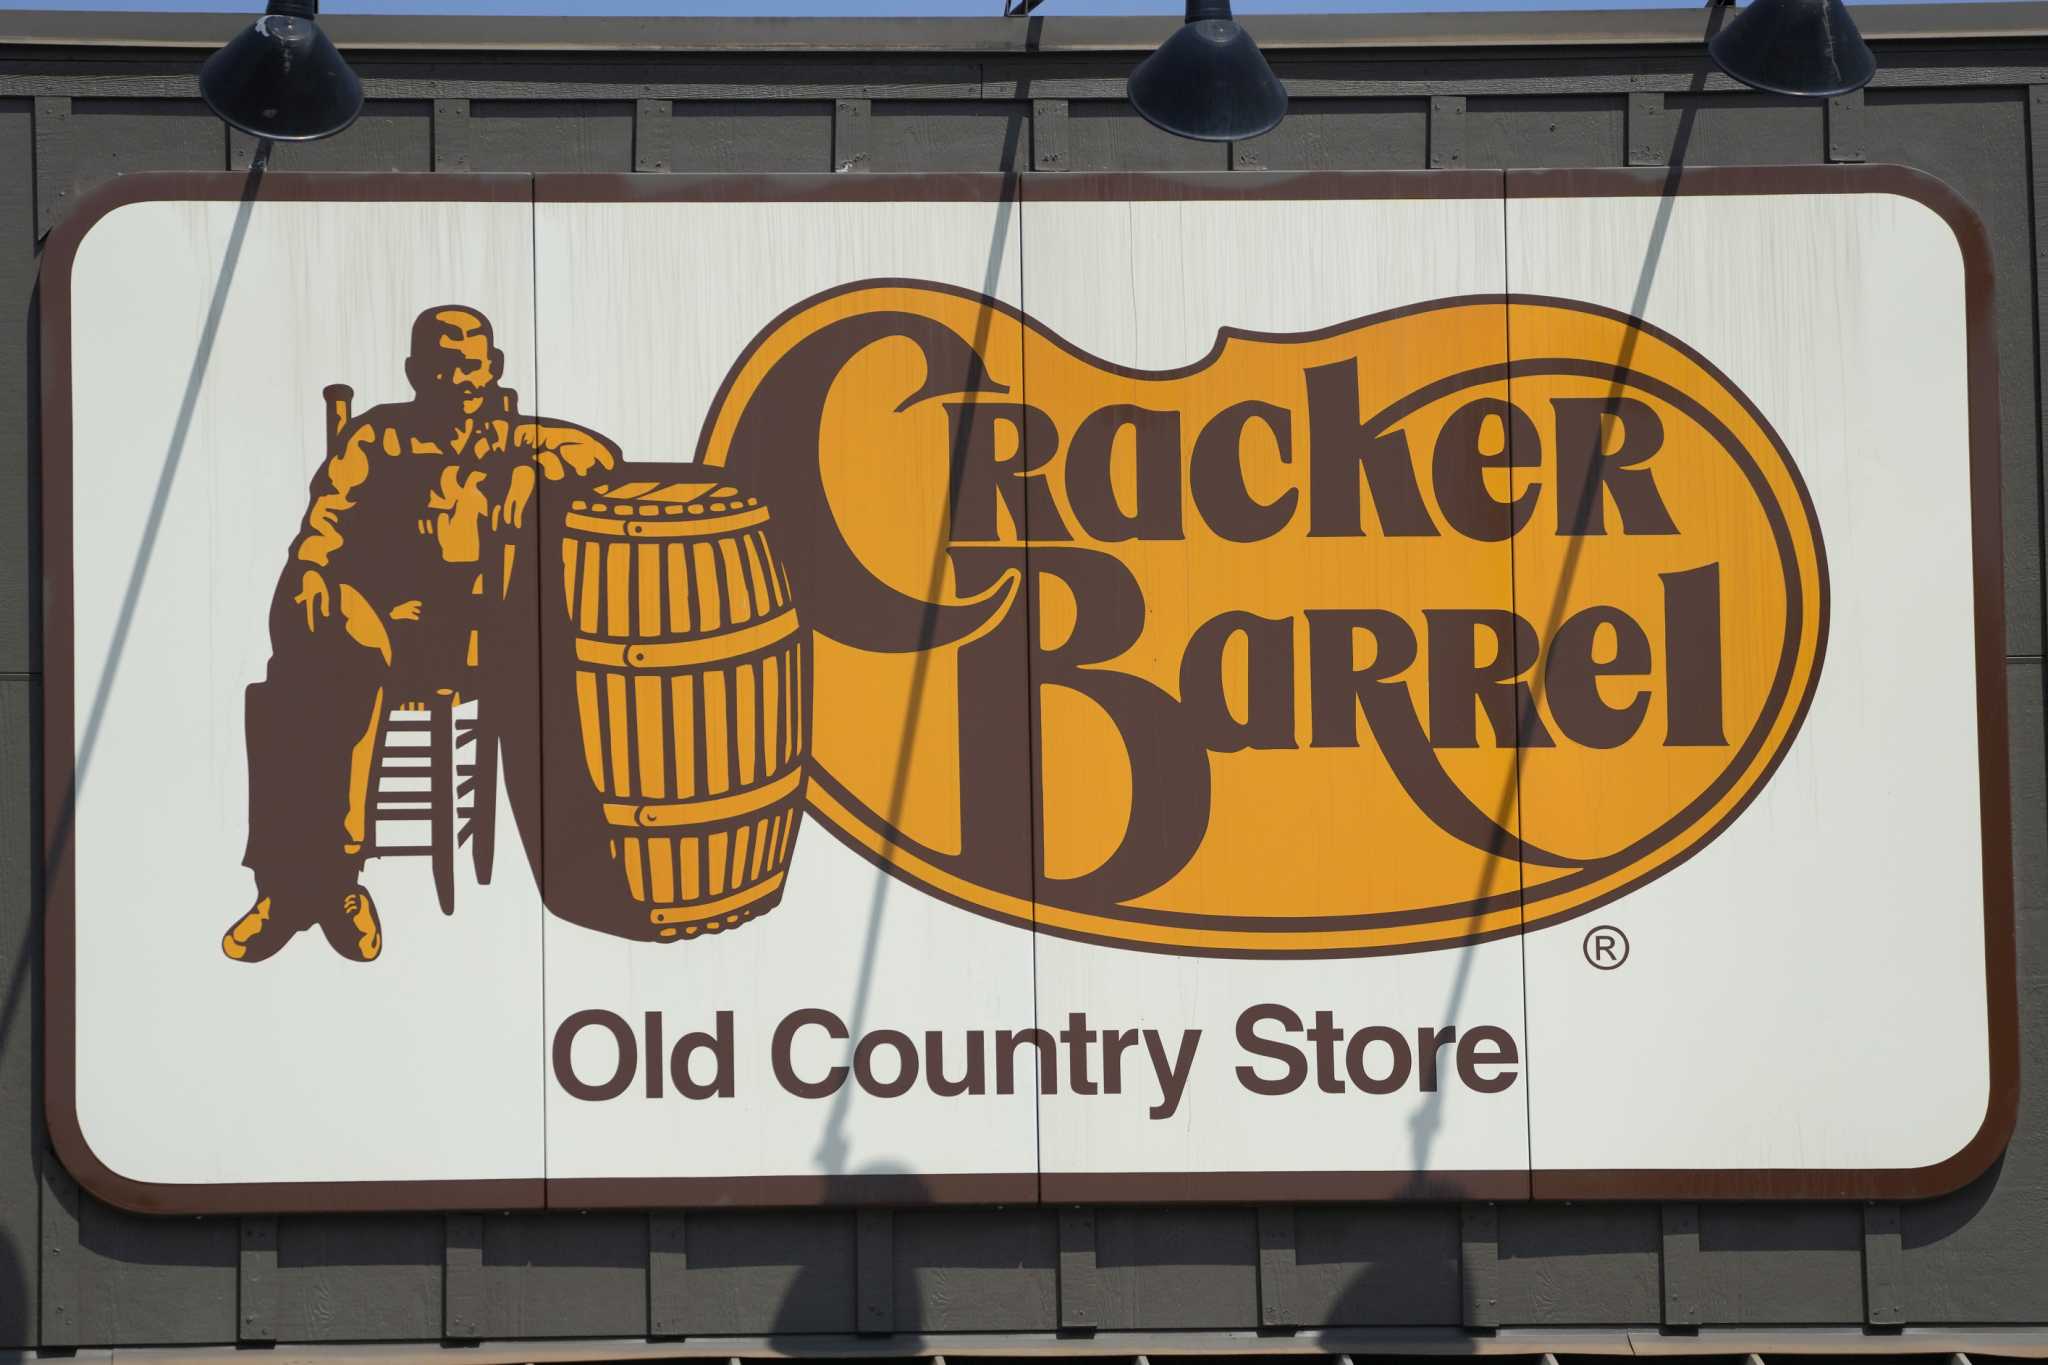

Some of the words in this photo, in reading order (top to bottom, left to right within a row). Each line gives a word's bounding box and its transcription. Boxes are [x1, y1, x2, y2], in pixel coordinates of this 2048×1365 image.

[552, 1008, 735, 1102] Old
[771, 1007, 1203, 1120] Country
[1234, 1002, 1519, 1096] Store
